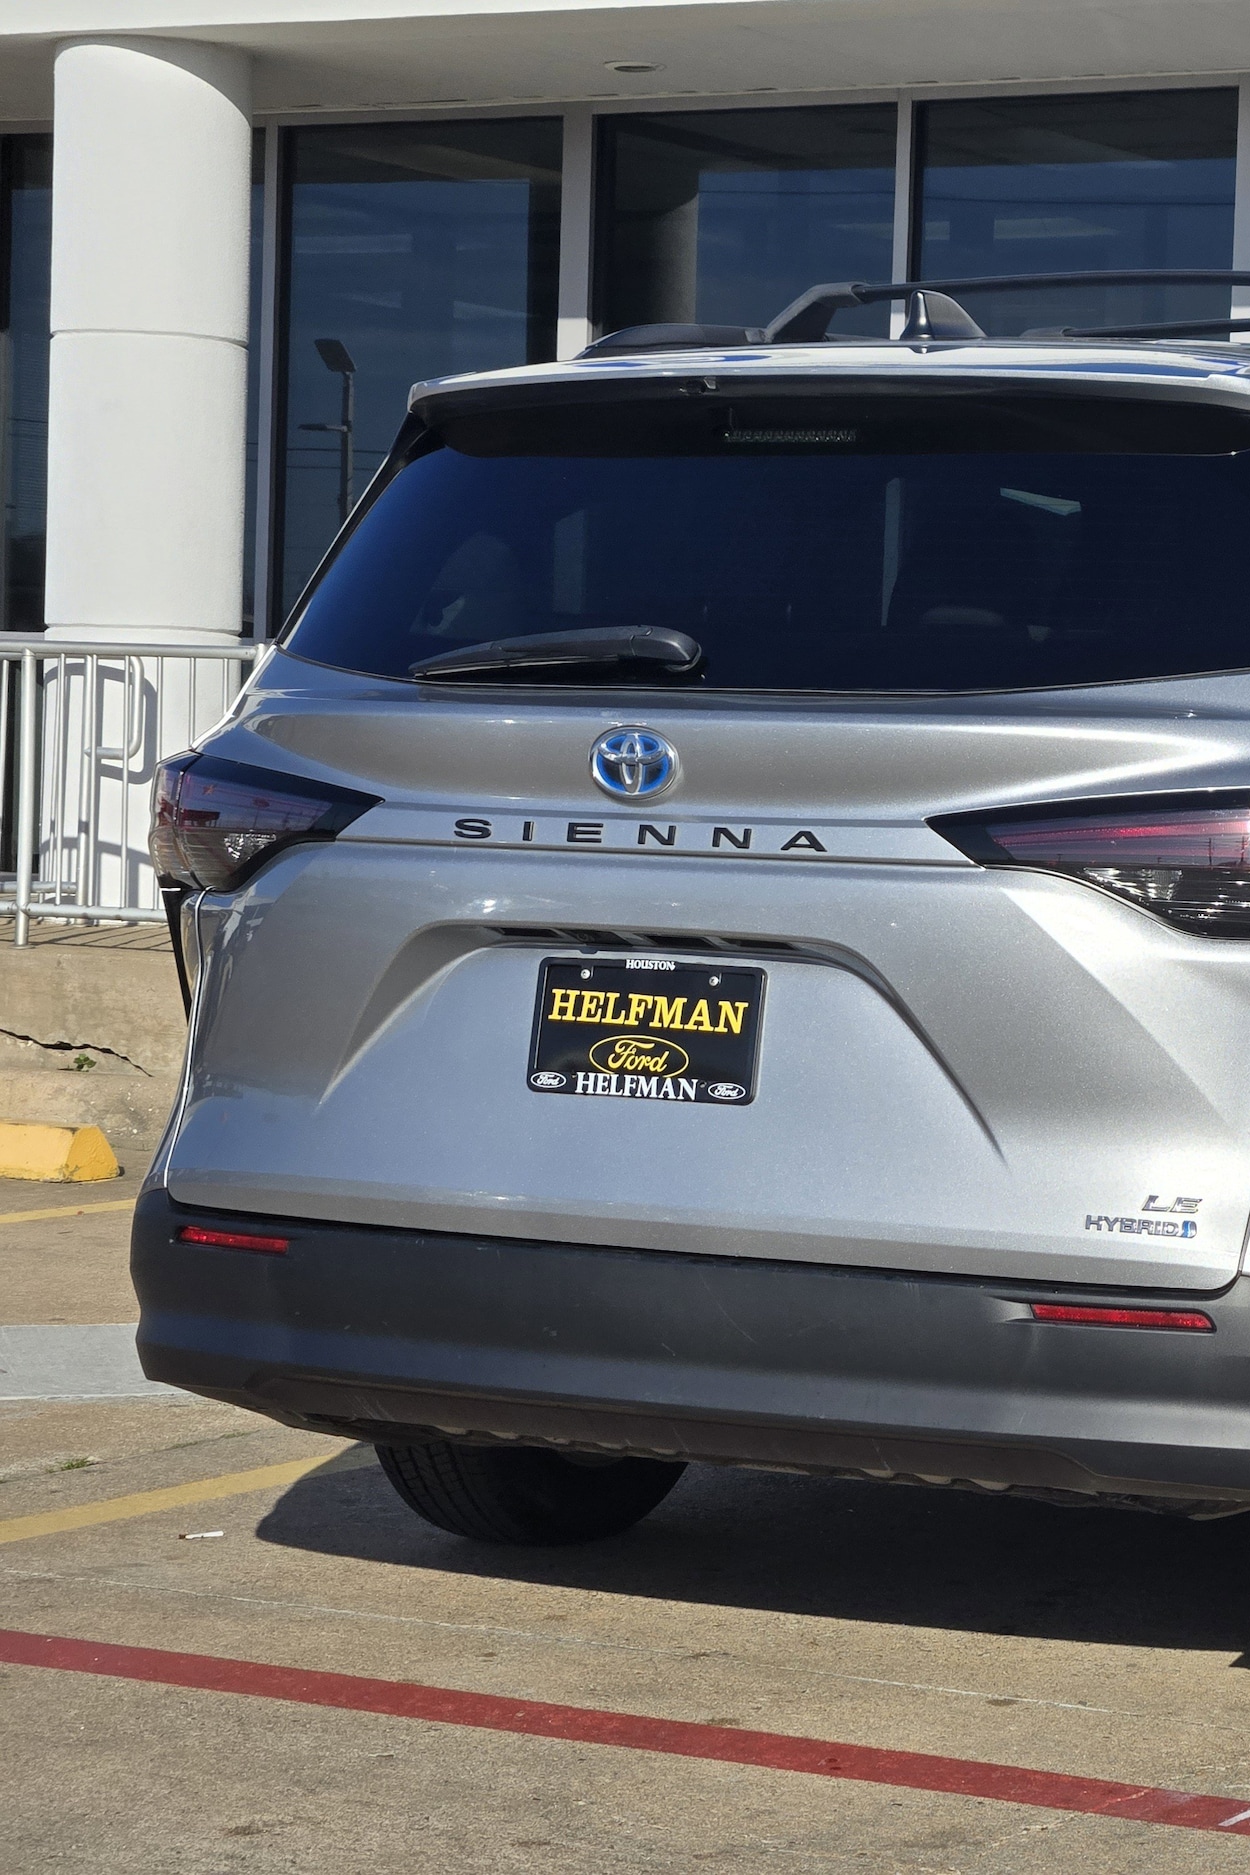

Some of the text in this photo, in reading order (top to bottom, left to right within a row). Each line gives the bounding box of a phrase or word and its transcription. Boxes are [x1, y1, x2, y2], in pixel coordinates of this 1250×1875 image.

[453, 818, 828, 853] SIENNA
[625, 959, 676, 971] HOUSTON
[547, 988, 749, 1034] HELFMAN
[607, 1039, 670, 1073] Ford
[535, 1074, 561, 1086] Ford
[574, 1071, 699, 1100] HELFMAN
[713, 1084, 740, 1097] Ford
[1142, 1195, 1203, 1214] LE
[1085, 1215, 1179, 1237] HYBRID
